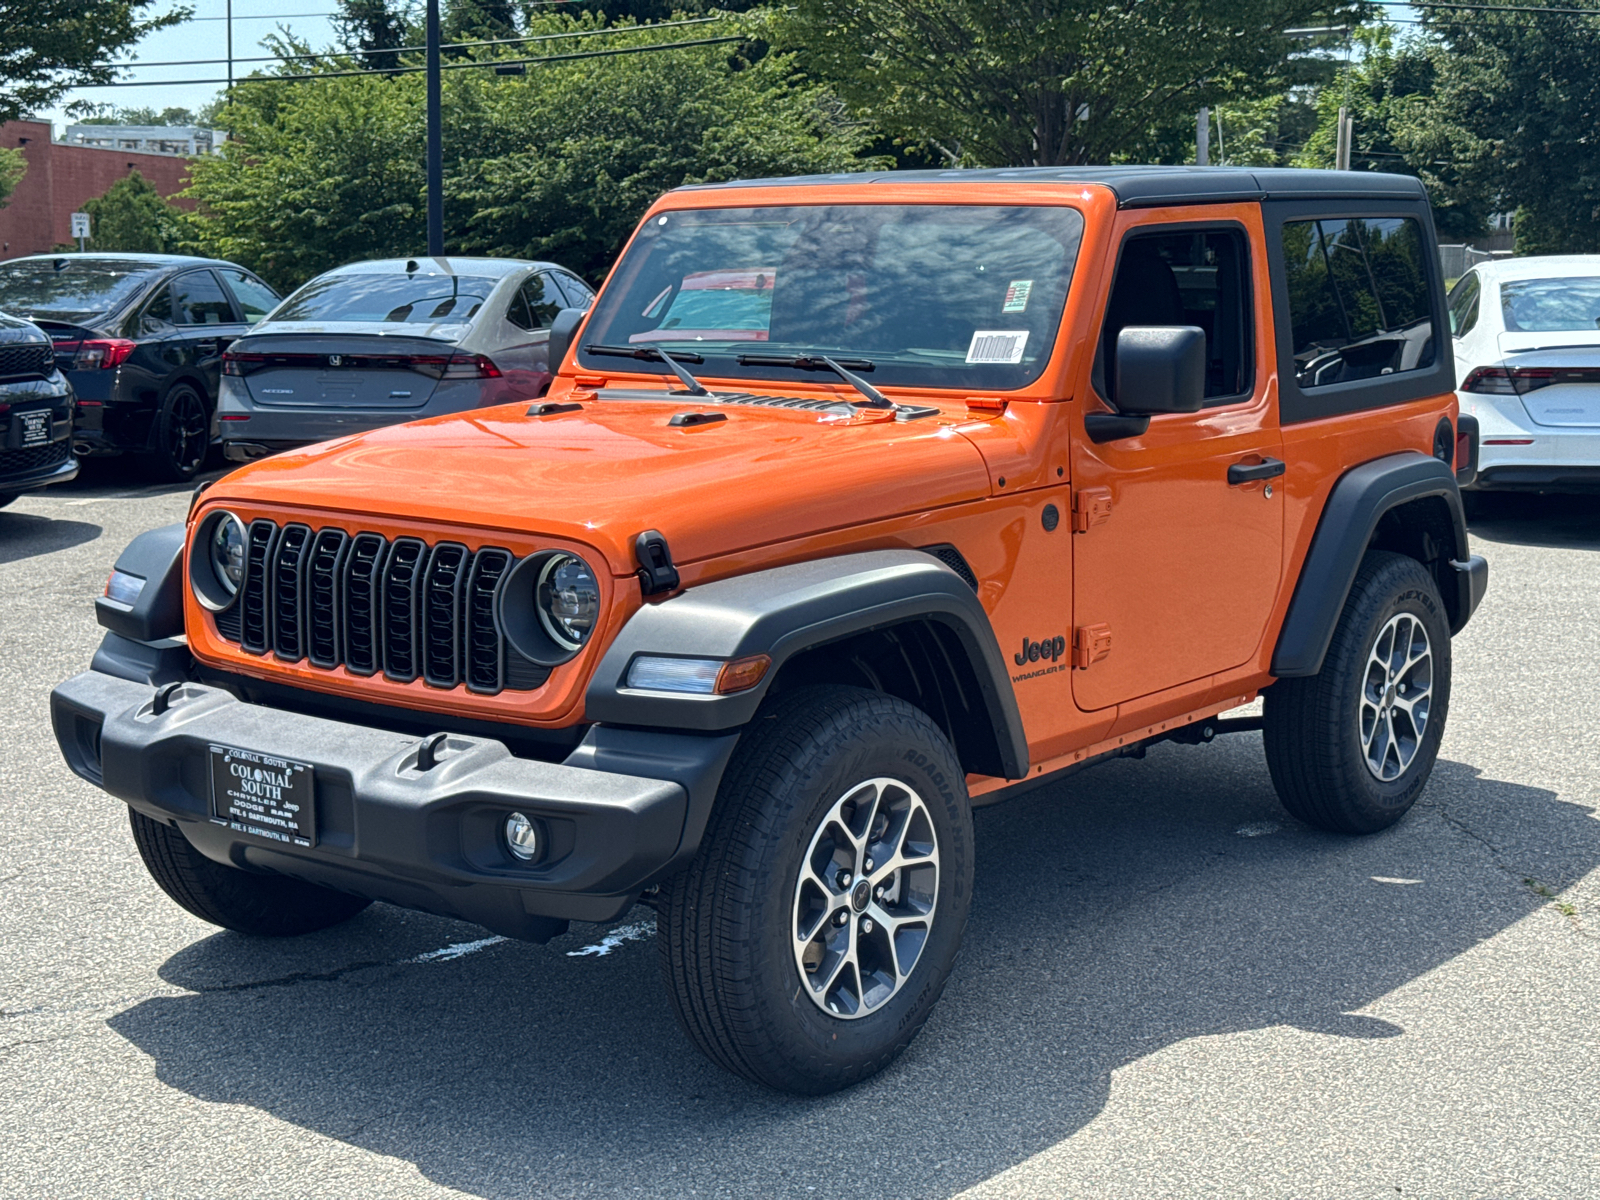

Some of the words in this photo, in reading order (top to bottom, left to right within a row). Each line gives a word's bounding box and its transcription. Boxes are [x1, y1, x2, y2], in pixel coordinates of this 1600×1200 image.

[1396, 590, 1437, 614] NEXEN
[1014, 635, 1066, 666] Jeep
[1012, 666, 1058, 683] WRANGLER
[229, 750, 261, 763] COLONIAL
[263, 757, 288, 769] SOUTH
[230, 763, 293, 789] COLONIAL
[902, 749, 960, 821] ROADIAN
[241, 779, 282, 800] SOUTH
[227, 790, 277, 807] CHRYSLER
[283, 801, 300, 812] Jeep
[234, 799, 265, 813] DODGE
[271, 809, 293, 818] RAM
[249, 812, 287, 828] DARTMOUTH,
[288, 821, 299, 829] MA
[281, 834, 290, 843] MA
